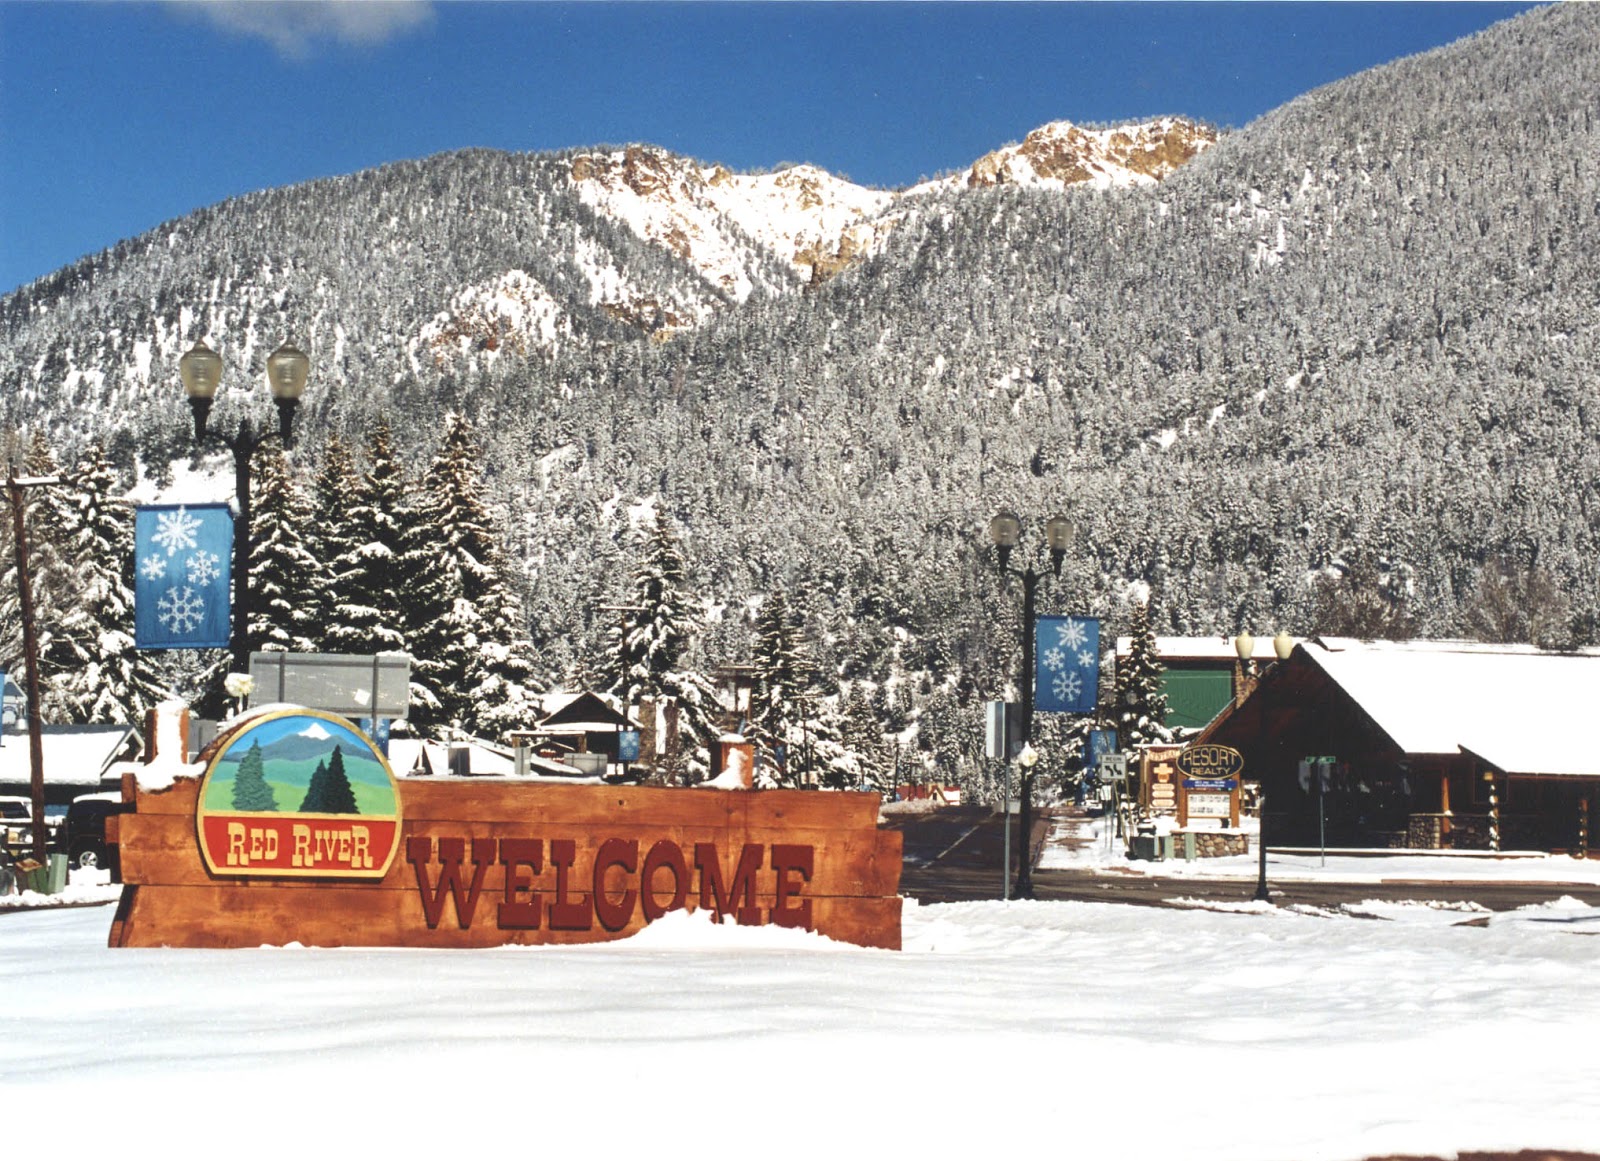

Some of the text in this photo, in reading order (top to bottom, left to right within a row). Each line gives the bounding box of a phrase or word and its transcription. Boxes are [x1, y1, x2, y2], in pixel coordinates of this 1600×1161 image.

[1183, 748, 1237, 766] RESORT
[1190, 767, 1231, 775] REALTY
[226, 822, 374, 868] RED RIVER
[406, 837, 814, 932] WELCOME
